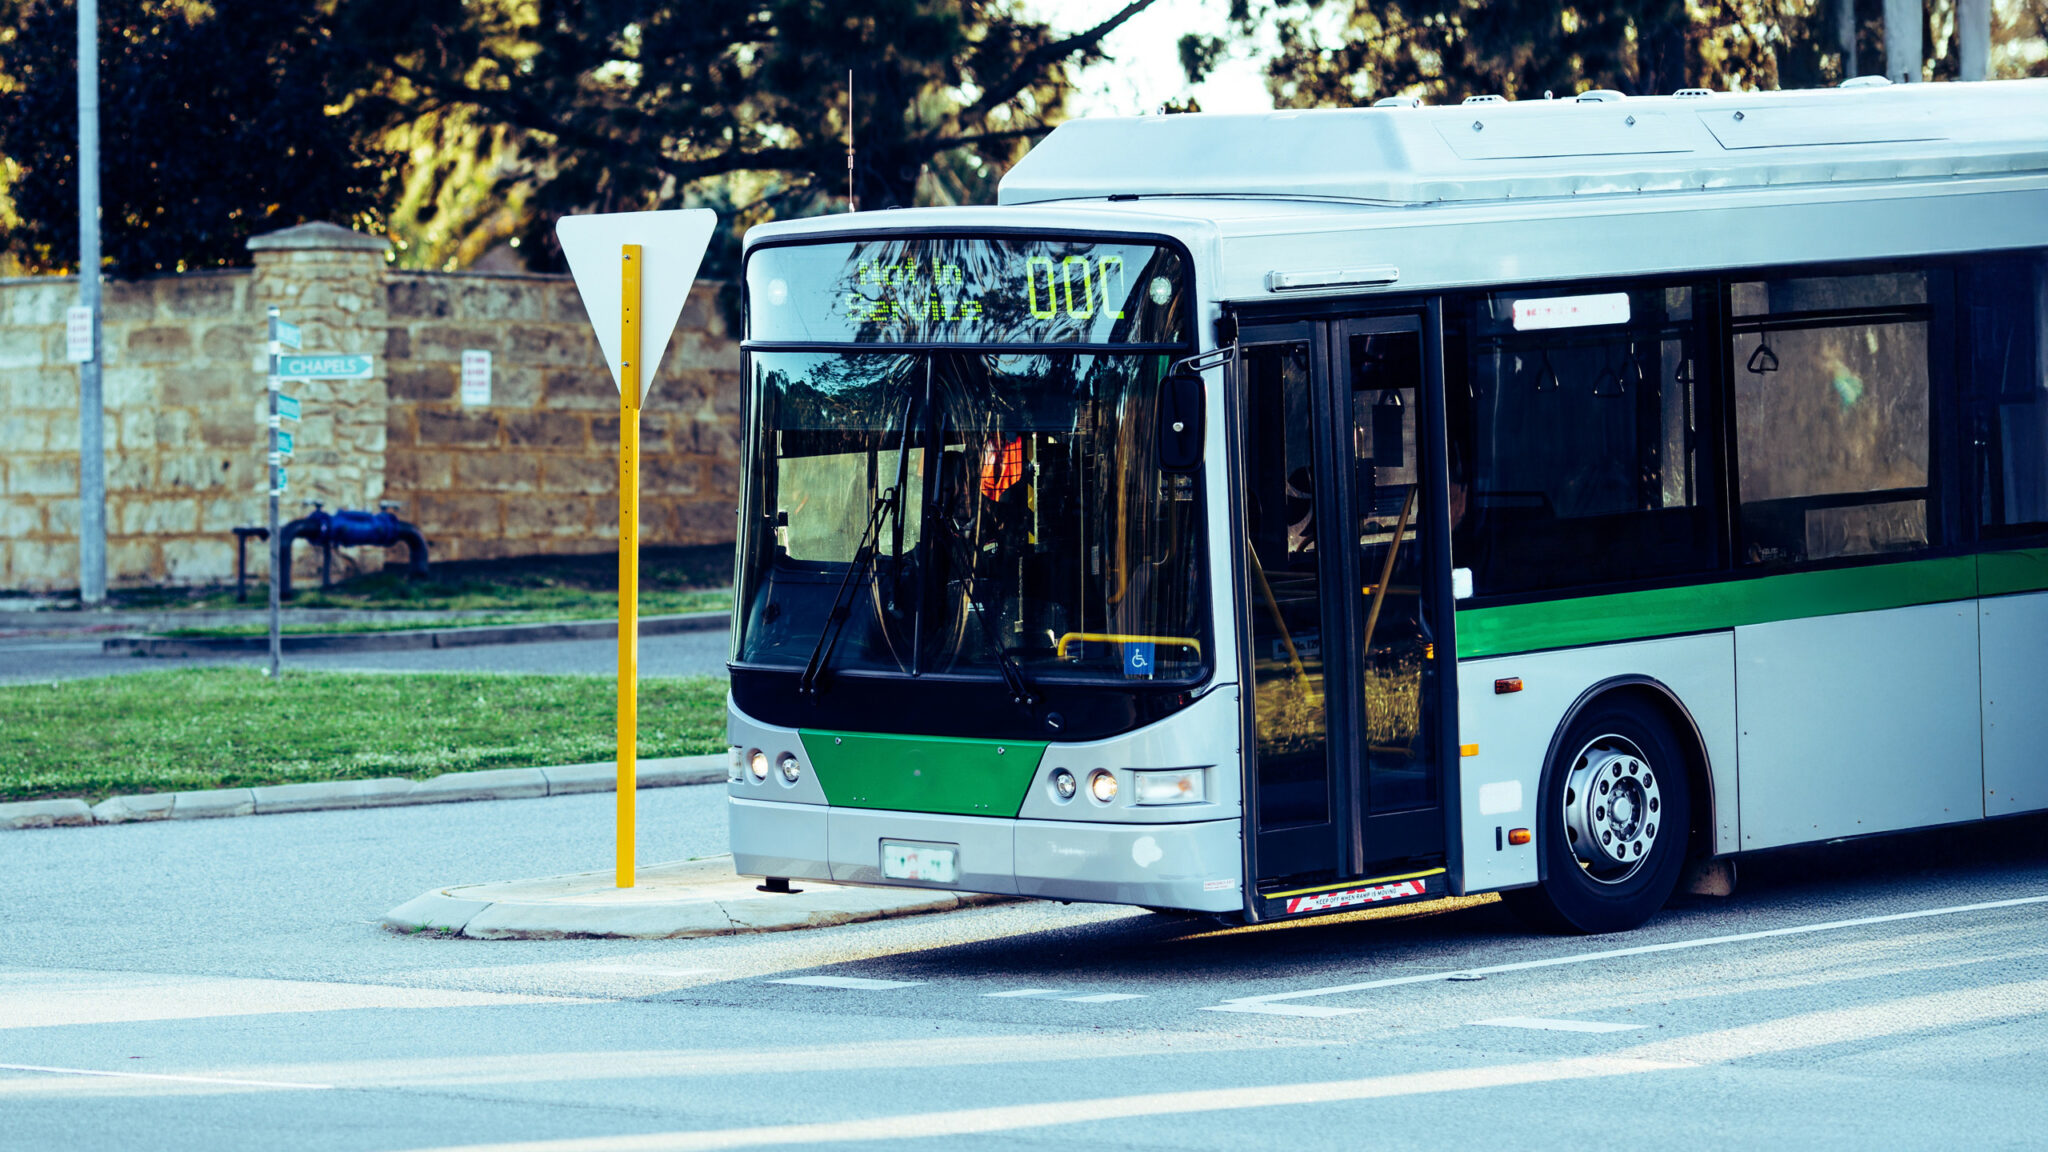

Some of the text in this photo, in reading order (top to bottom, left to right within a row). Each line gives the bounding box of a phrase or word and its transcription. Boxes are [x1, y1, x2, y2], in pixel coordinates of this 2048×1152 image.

[859, 257, 962, 285] Not In
[845, 293, 983, 321] Service
[288, 359, 357, 374] CHAPELS
[1316, 897, 1329, 905] KEEP
[1330, 896, 1339, 904] OFF
[1340, 894, 1355, 902] WHEN
[1356, 892, 1370, 900] RAMP
[1378, 888, 1397, 896] MOVING
